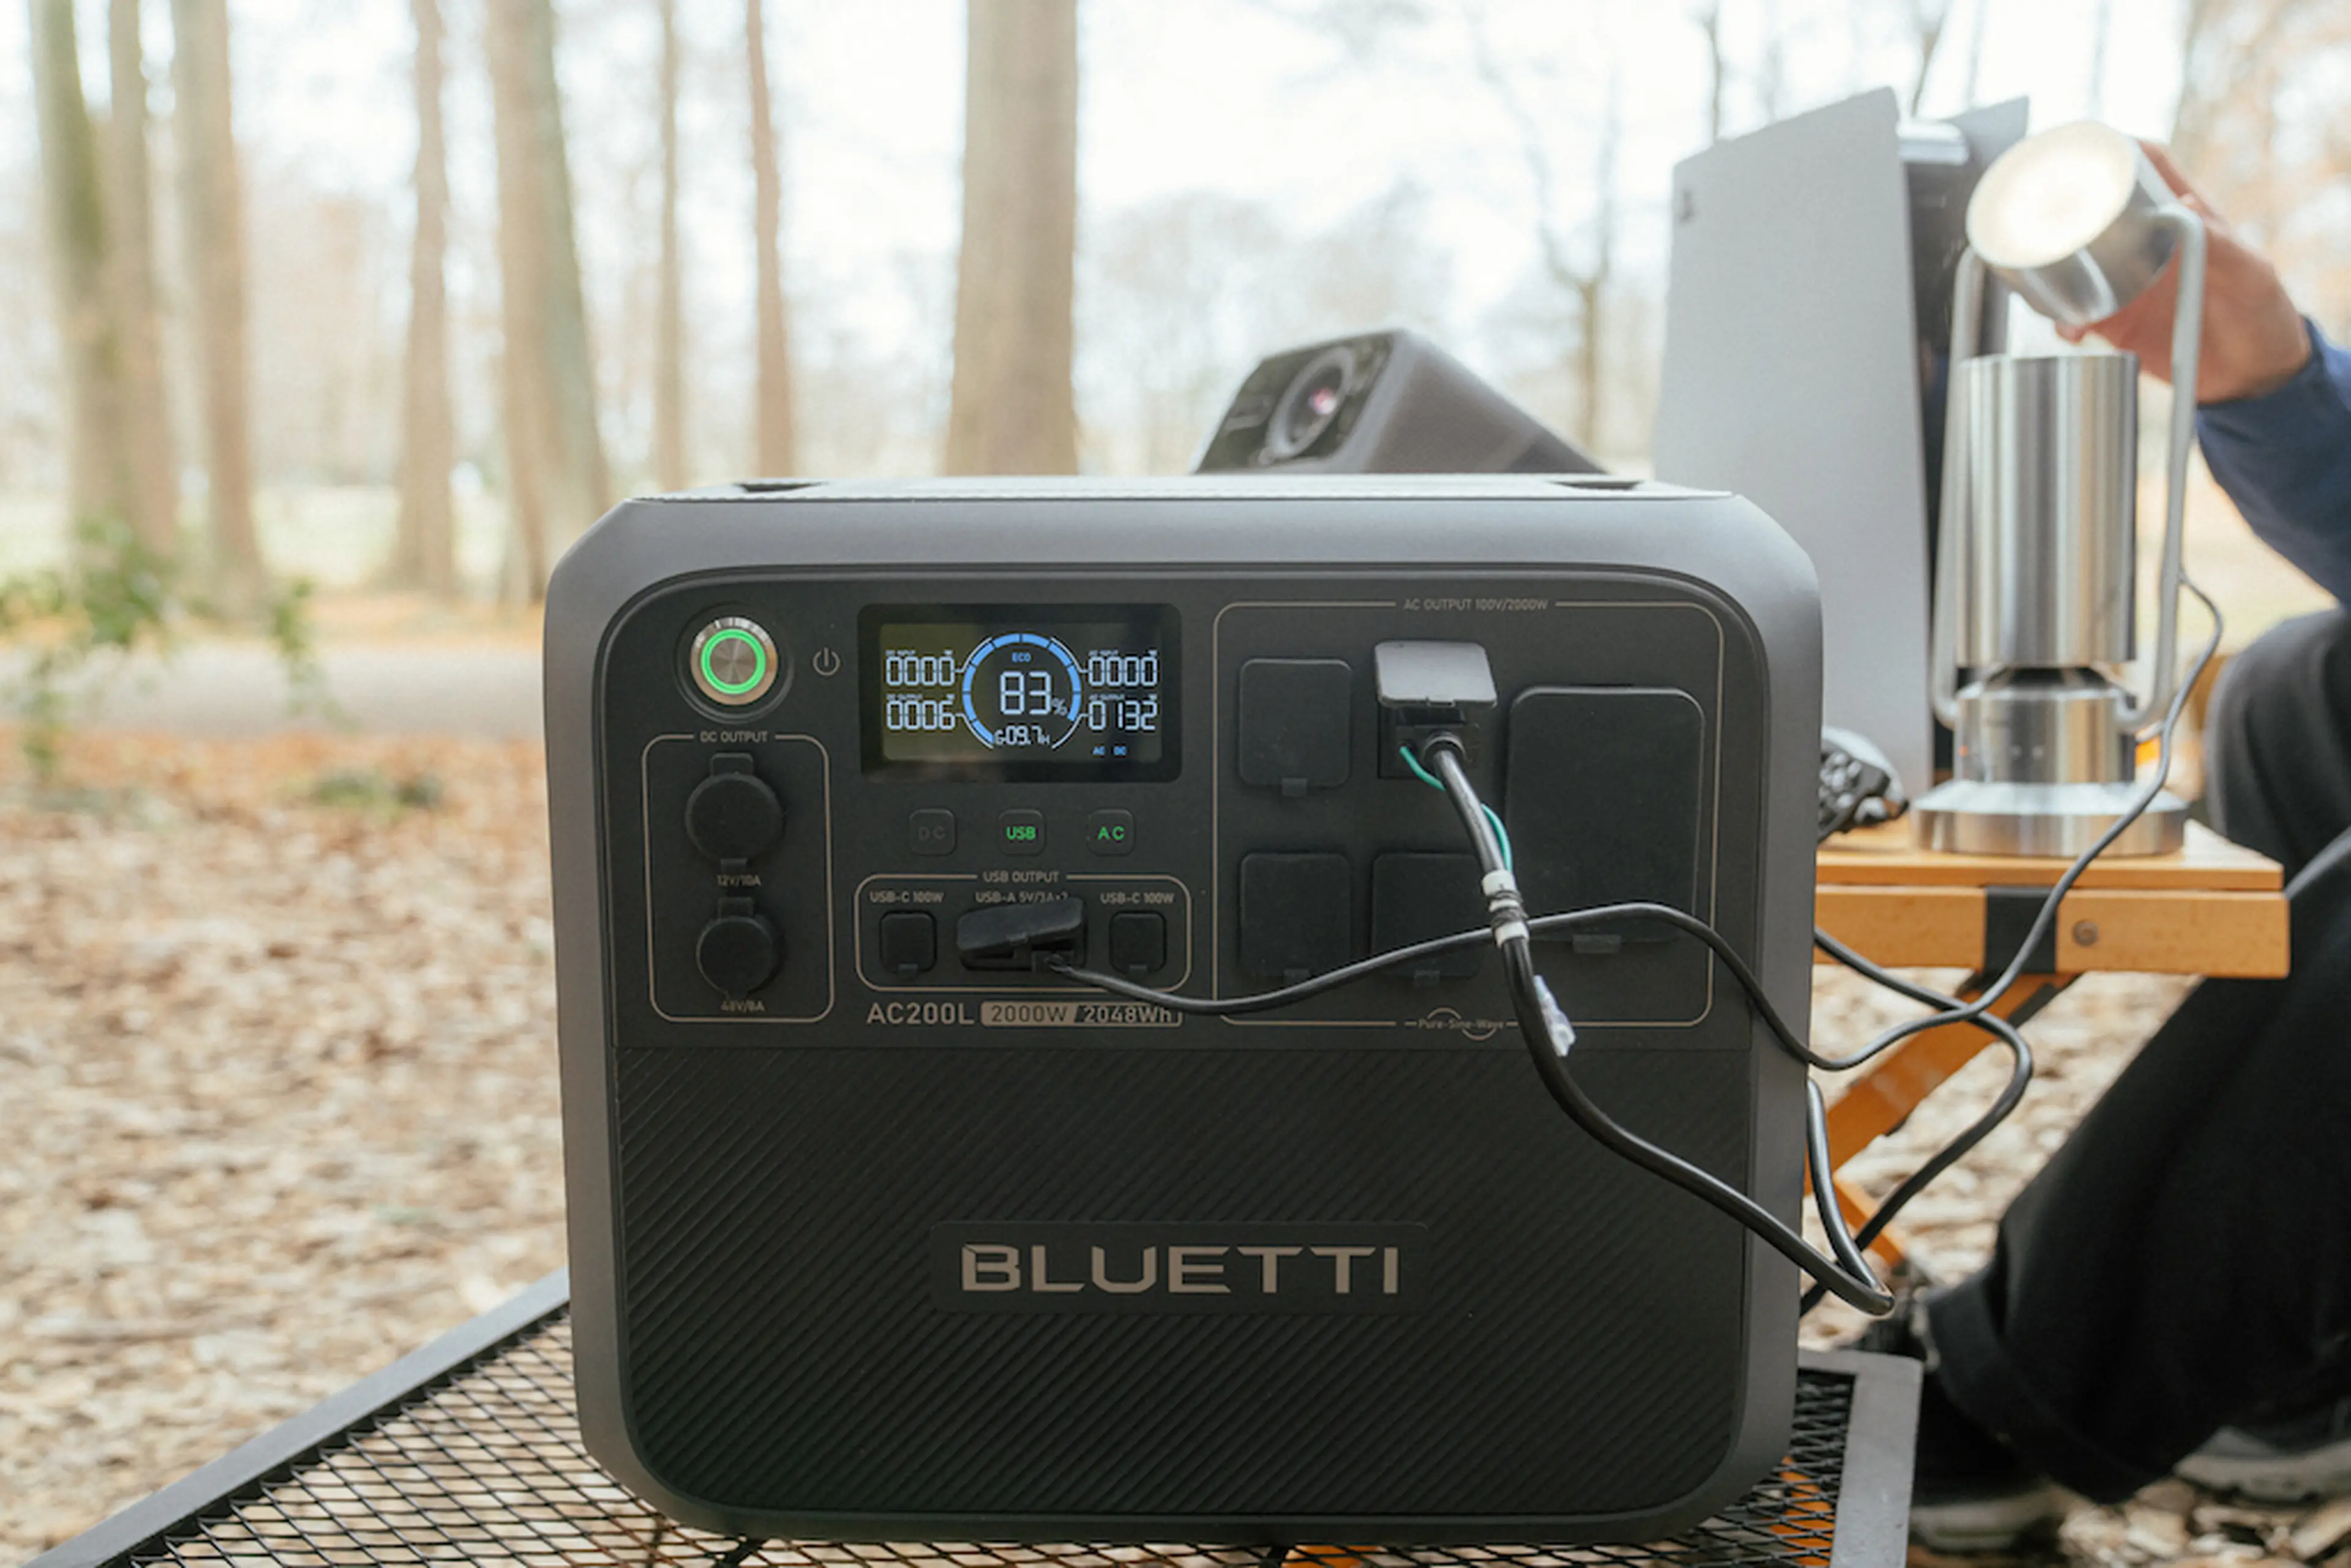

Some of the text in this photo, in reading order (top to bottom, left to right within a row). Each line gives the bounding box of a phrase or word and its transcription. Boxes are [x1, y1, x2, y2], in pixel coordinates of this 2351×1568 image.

[1403, 598, 1549, 612] AC OUTPUT 100V/2000W
[1012, 653, 1032, 662] ECO
[886, 656, 955, 686] 0000
[1089, 656, 1157, 686] 0000
[887, 700, 955, 730] 0006
[1089, 700, 1157, 730] 0132
[700, 730, 768, 743] DC OUTPUT
[918, 825, 947, 841] DC
[1006, 826, 1037, 840] USB
[1097, 826, 1125, 841] AC
[983, 870, 1060, 883] USB OUTPUT
[869, 891, 910, 903] USB-C
[975, 891, 1016, 903] USB-A
[1100, 891, 1141, 904] USB-C
[866, 1002, 1172, 1025] AC200L 2000W 2048Wh
[961, 1243, 1400, 1294] BLUETTI
